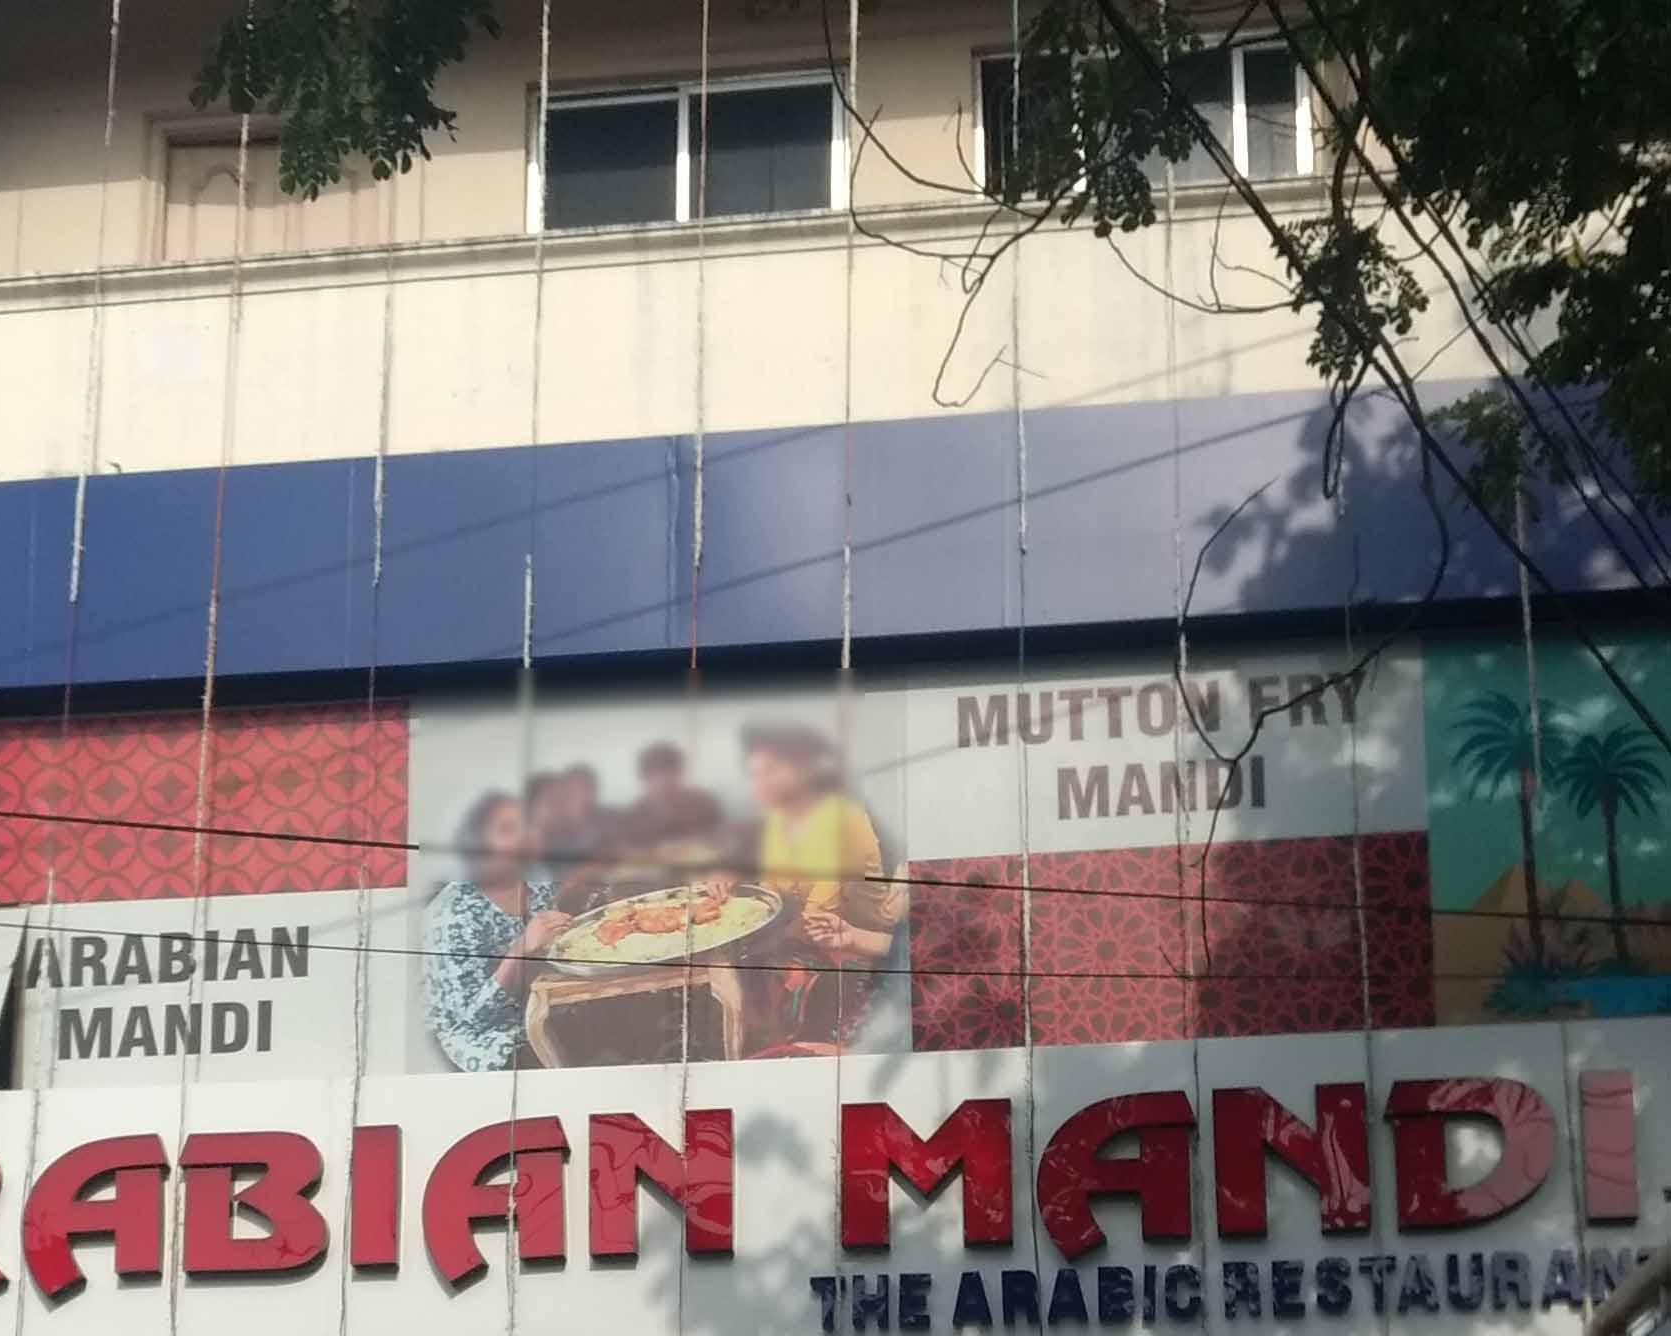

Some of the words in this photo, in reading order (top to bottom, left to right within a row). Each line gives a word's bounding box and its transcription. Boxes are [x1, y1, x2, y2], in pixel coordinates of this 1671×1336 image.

[956, 680, 1221, 749] MUTTON
[1247, 668, 1367, 730] FRY
[1056, 755, 1267, 821] MANDI
[26, 925, 310, 989] ARABIAN
[58, 1000, 272, 1060] MANDI
[840, 1070, 1640, 1261] MANDI
[810, 1273, 932, 1332] THE
[952, 1264, 1202, 1330] ARABIC
[1222, 1248, 1657, 1320] RESTAURAN
